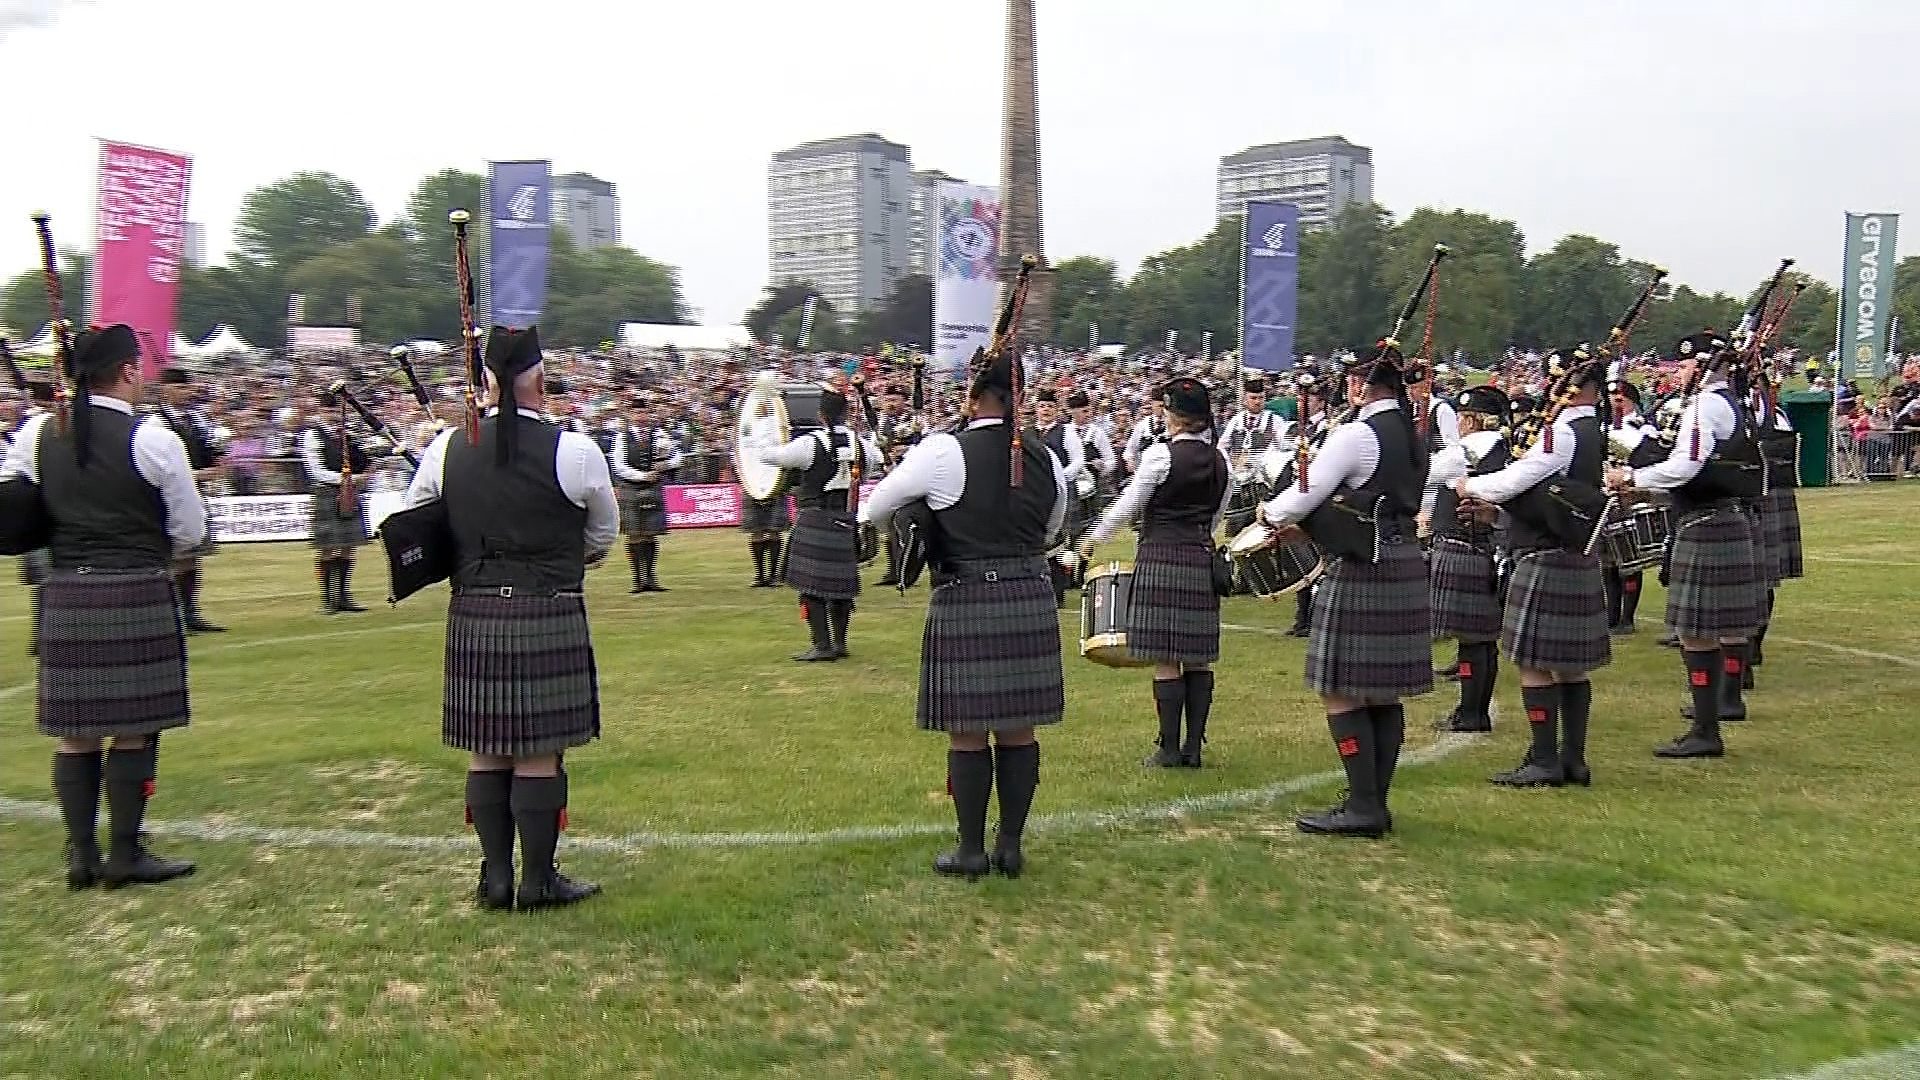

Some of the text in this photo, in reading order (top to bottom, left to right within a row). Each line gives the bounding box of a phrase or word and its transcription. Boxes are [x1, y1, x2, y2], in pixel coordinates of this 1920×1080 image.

[100, 153, 135, 241] PEOPLE
[127, 155, 164, 225] MAKE
[147, 159, 188, 283] GLASGOW
[683, 487, 736, 501] PEOPLE
[233, 501, 294, 518] PIPE
[695, 499, 737, 512] MAKE
[666, 511, 738, 525] GLASGOW
